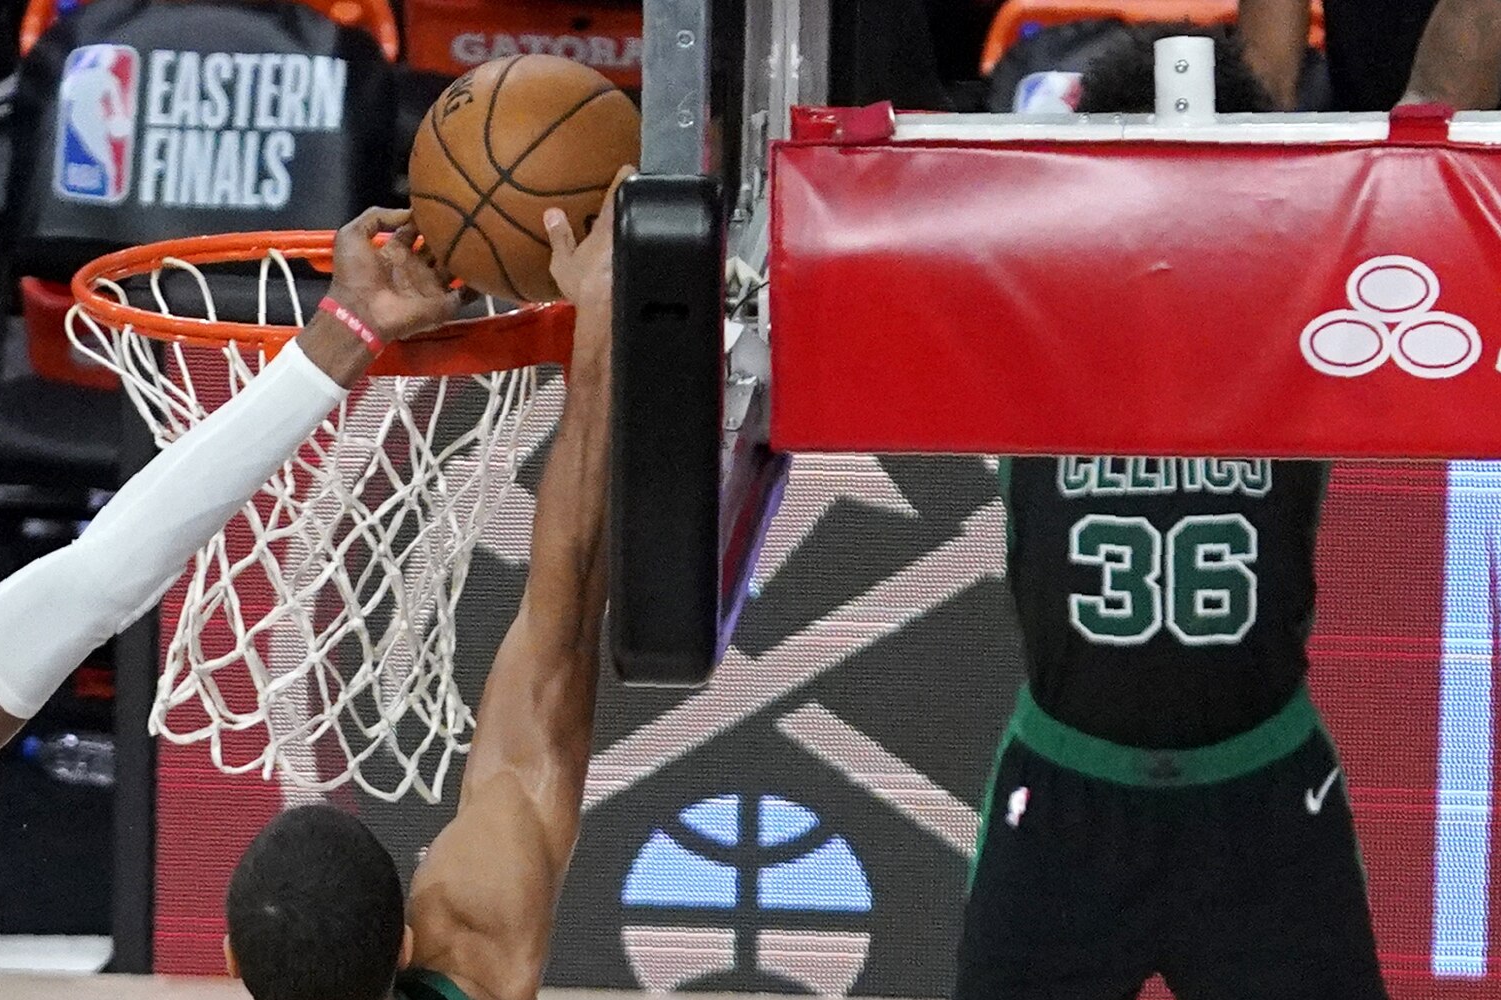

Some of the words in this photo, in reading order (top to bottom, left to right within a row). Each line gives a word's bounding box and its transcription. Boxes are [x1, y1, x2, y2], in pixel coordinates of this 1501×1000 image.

[147, 48, 348, 128] EASTERN
[139, 127, 296, 209] FINALS
[1069, 513, 1258, 646] 36
